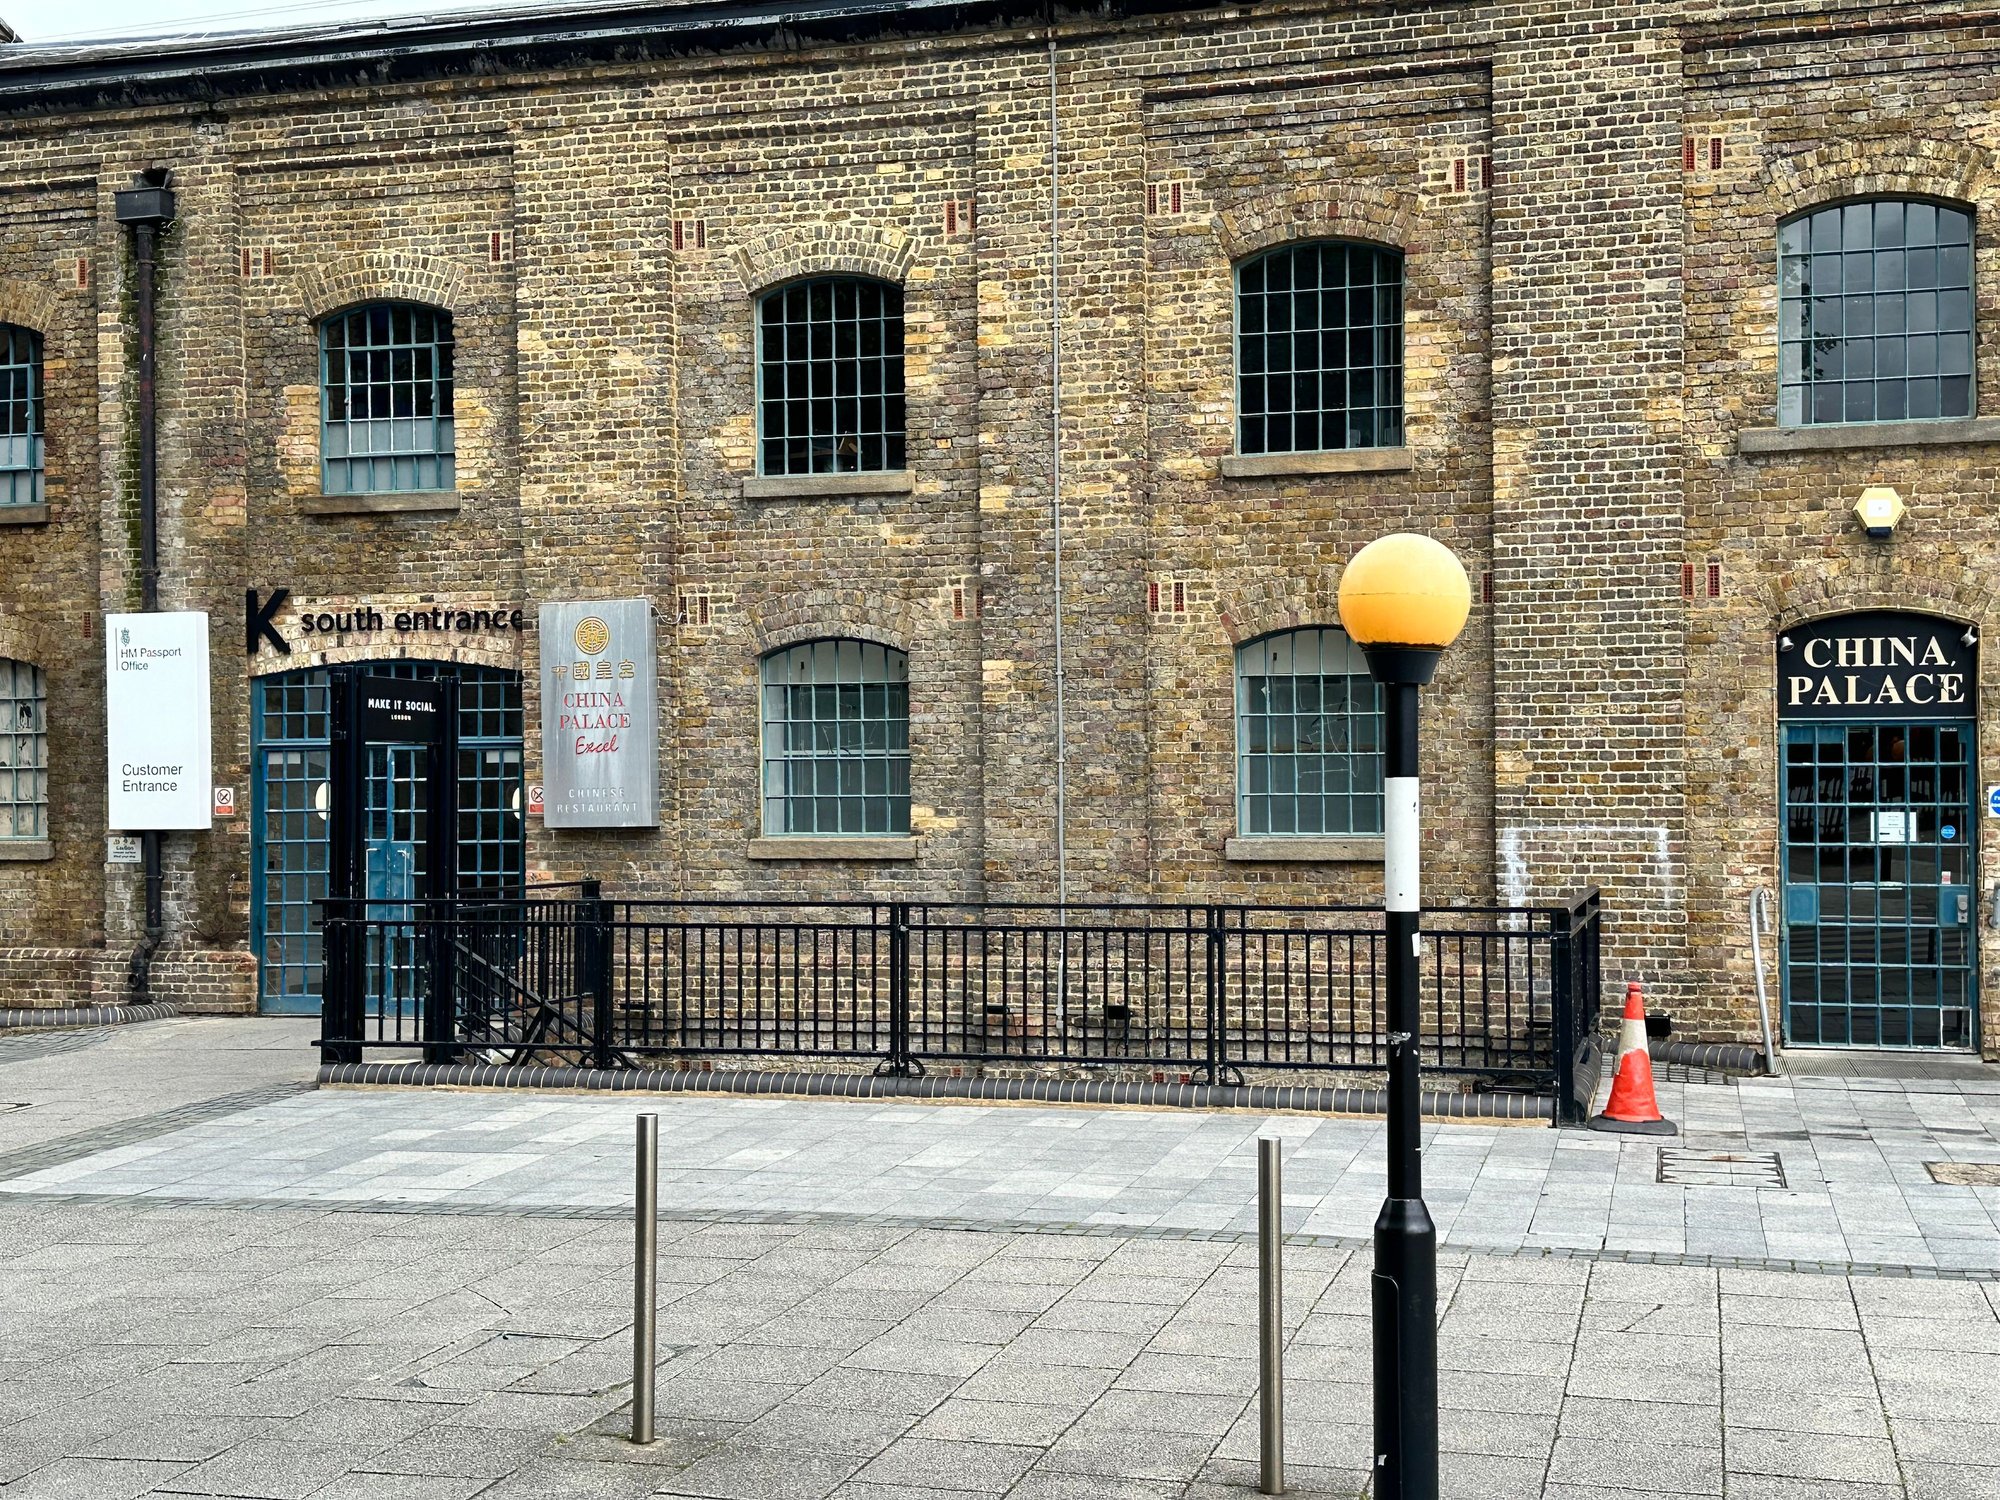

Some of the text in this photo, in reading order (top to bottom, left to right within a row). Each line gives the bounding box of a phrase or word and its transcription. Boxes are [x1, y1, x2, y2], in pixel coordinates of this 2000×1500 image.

[246, 588, 523, 654] K south entrance
[120, 647, 182, 660] HM Passport
[121, 660, 149, 671] Office
[1787, 673, 1965, 706] PALACE
[367, 697, 437, 712] MAKE IT SOCIAL.
[563, 692, 625, 708] CHINA
[559, 713, 631, 730] PALACE
[575, 734, 620, 756] Excel
[122, 763, 183, 777] Customer
[122, 779, 178, 793] Entrance
[568, 787, 625, 799] CHINESE
[556, 802, 637, 814] RESTAURANT
